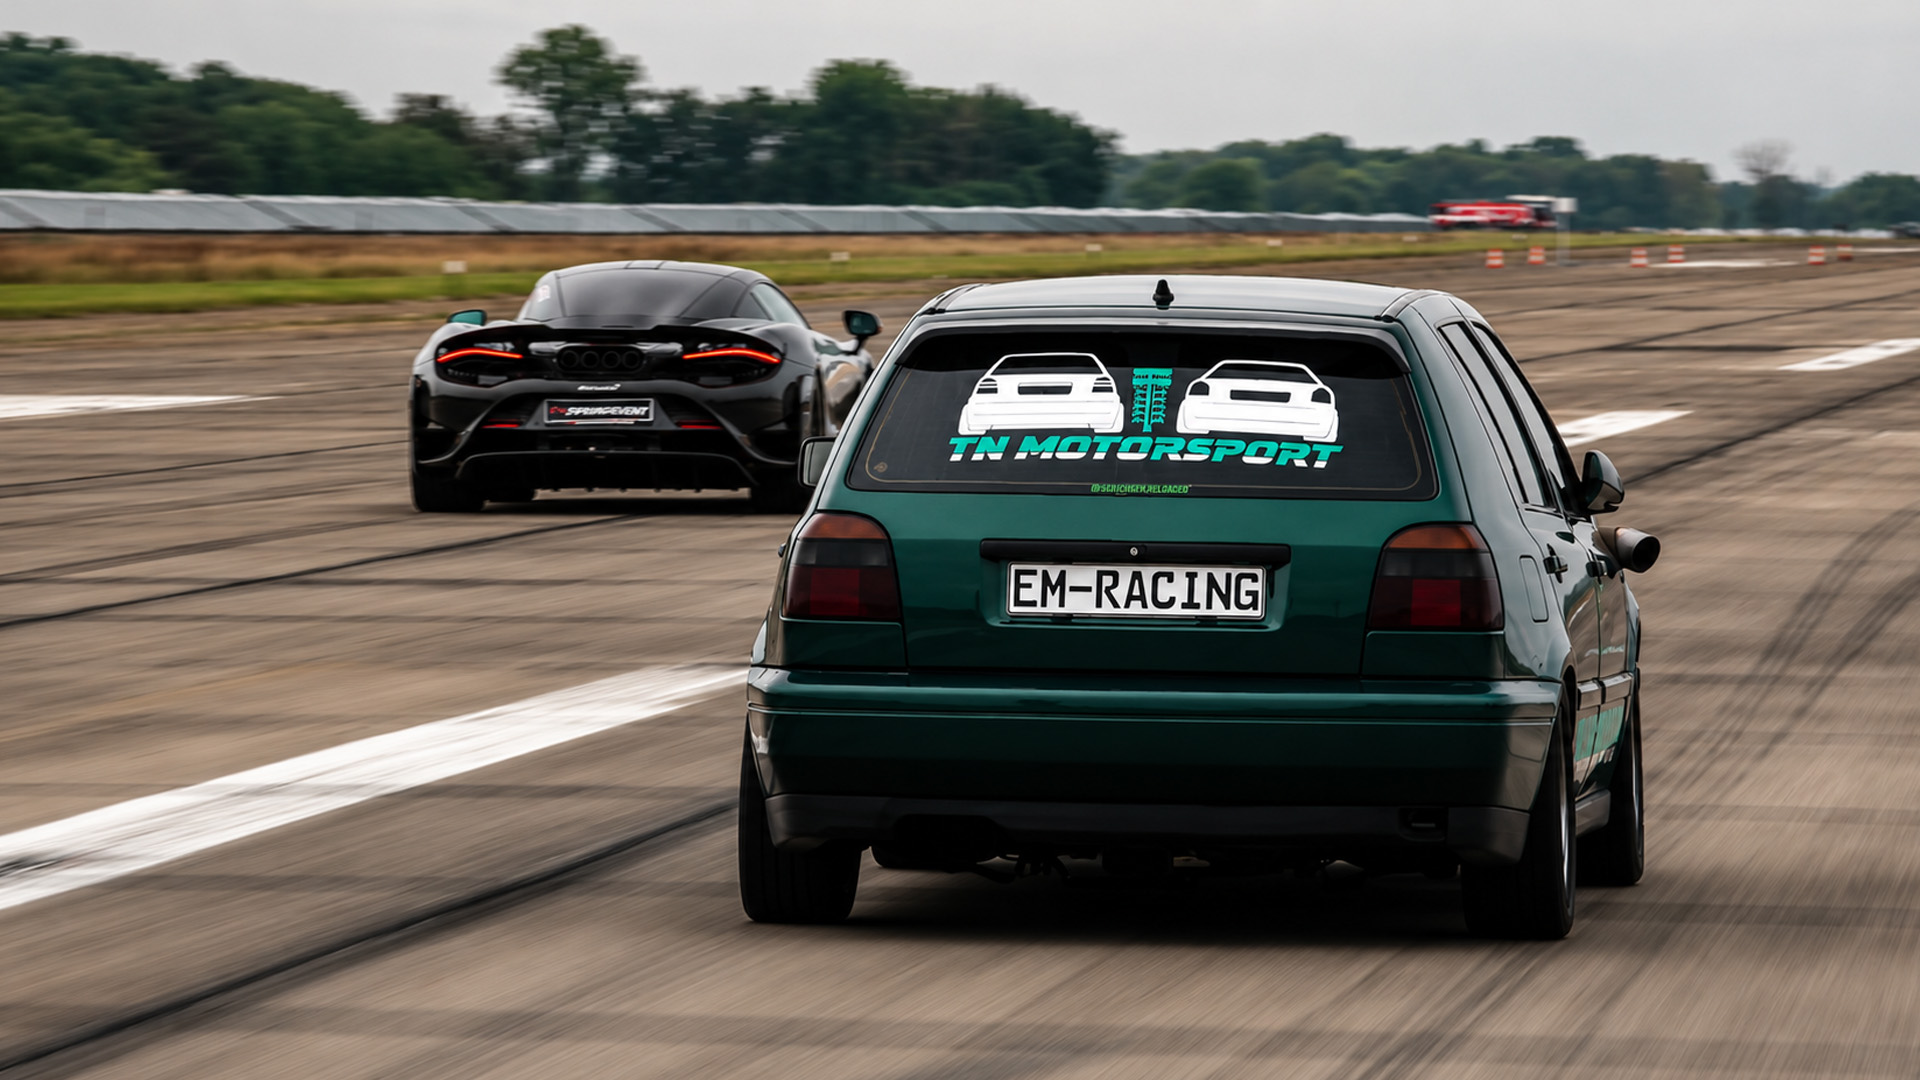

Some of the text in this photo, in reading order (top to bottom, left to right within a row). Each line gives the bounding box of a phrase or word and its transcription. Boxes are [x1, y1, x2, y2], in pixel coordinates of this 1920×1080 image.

[949, 435, 1345, 469] TN MOTORSPORT
[1013, 569, 1259, 611] EM-RACING
